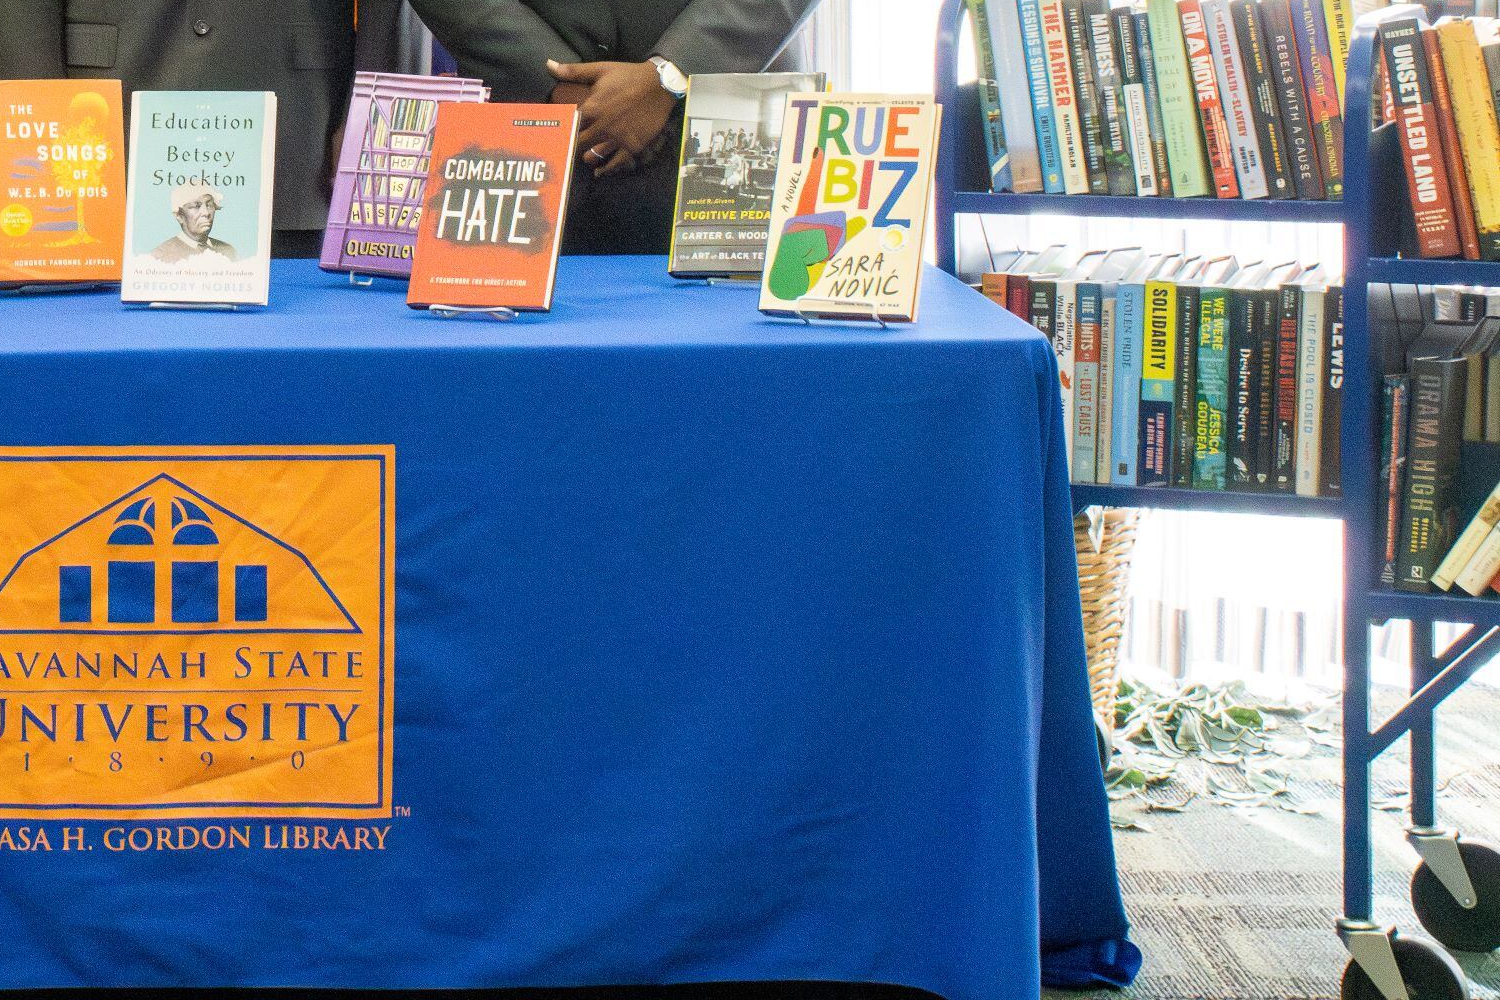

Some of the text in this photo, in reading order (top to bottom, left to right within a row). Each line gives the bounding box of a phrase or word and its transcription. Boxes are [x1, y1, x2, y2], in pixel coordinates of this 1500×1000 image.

[1384, 28, 1415, 38] HAYNES
[1182, 12, 1216, 103] ON A MOVE
[1043, 2, 1076, 168] THE HAMMER HAMILTON NOLAN
[1090, 14, 1115, 77] MADNESS
[1109, 121, 1123, 151] HYLTON
[9, 104, 33, 115] THE
[151, 113, 253, 130] Education
[1275, 35, 1311, 180] REBELS WITH A CAUSE
[1392, 44, 1426, 149] UNSETTLED
[1411, 154, 1438, 203] LAND
[6, 122, 59, 139] LOVE
[37, 145, 107, 161] SONGS
[791, 100, 920, 163] TRUE
[73, 170, 89, 180] OF
[152, 169, 245, 186] Stockton
[167, 146, 235, 167] Betsey
[445, 159, 546, 182] COMBATING
[8, 187, 51, 198] W.E.B.
[78, 186, 108, 197] BOIS
[823, 159, 919, 228] BIZ
[436, 188, 539, 244] HATE
[682, 231, 723, 240] CARTER
[684, 211, 771, 220] FUGITIVE PEDA
[132, 282, 253, 292] GREGORY NOBLES
[825, 252, 884, 277] SARA
[828, 269, 900, 297] NOVIĆ
[1056, 296, 1064, 357] While BLACK
[1065, 303, 1074, 350] Negotiating
[1122, 291, 1133, 369] STOLEN PRIDE
[1151, 288, 1167, 370] SOLIDARITY
[1201, 300, 1212, 345] ILLEGAL
[1212, 298, 1225, 350] WE WERE
[1330, 322, 1344, 389] LEWIS
[1079, 379, 1092, 437] LOST CAUSE
[1208, 408, 1220, 455] JESSICA
[1411, 375, 1441, 512] DRAMA HIGH
[234, 645, 363, 679] STATE
[62, 827, 93, 850] H.
[103, 826, 251, 851] GORDON
[264, 825, 393, 850] LIBRARY
